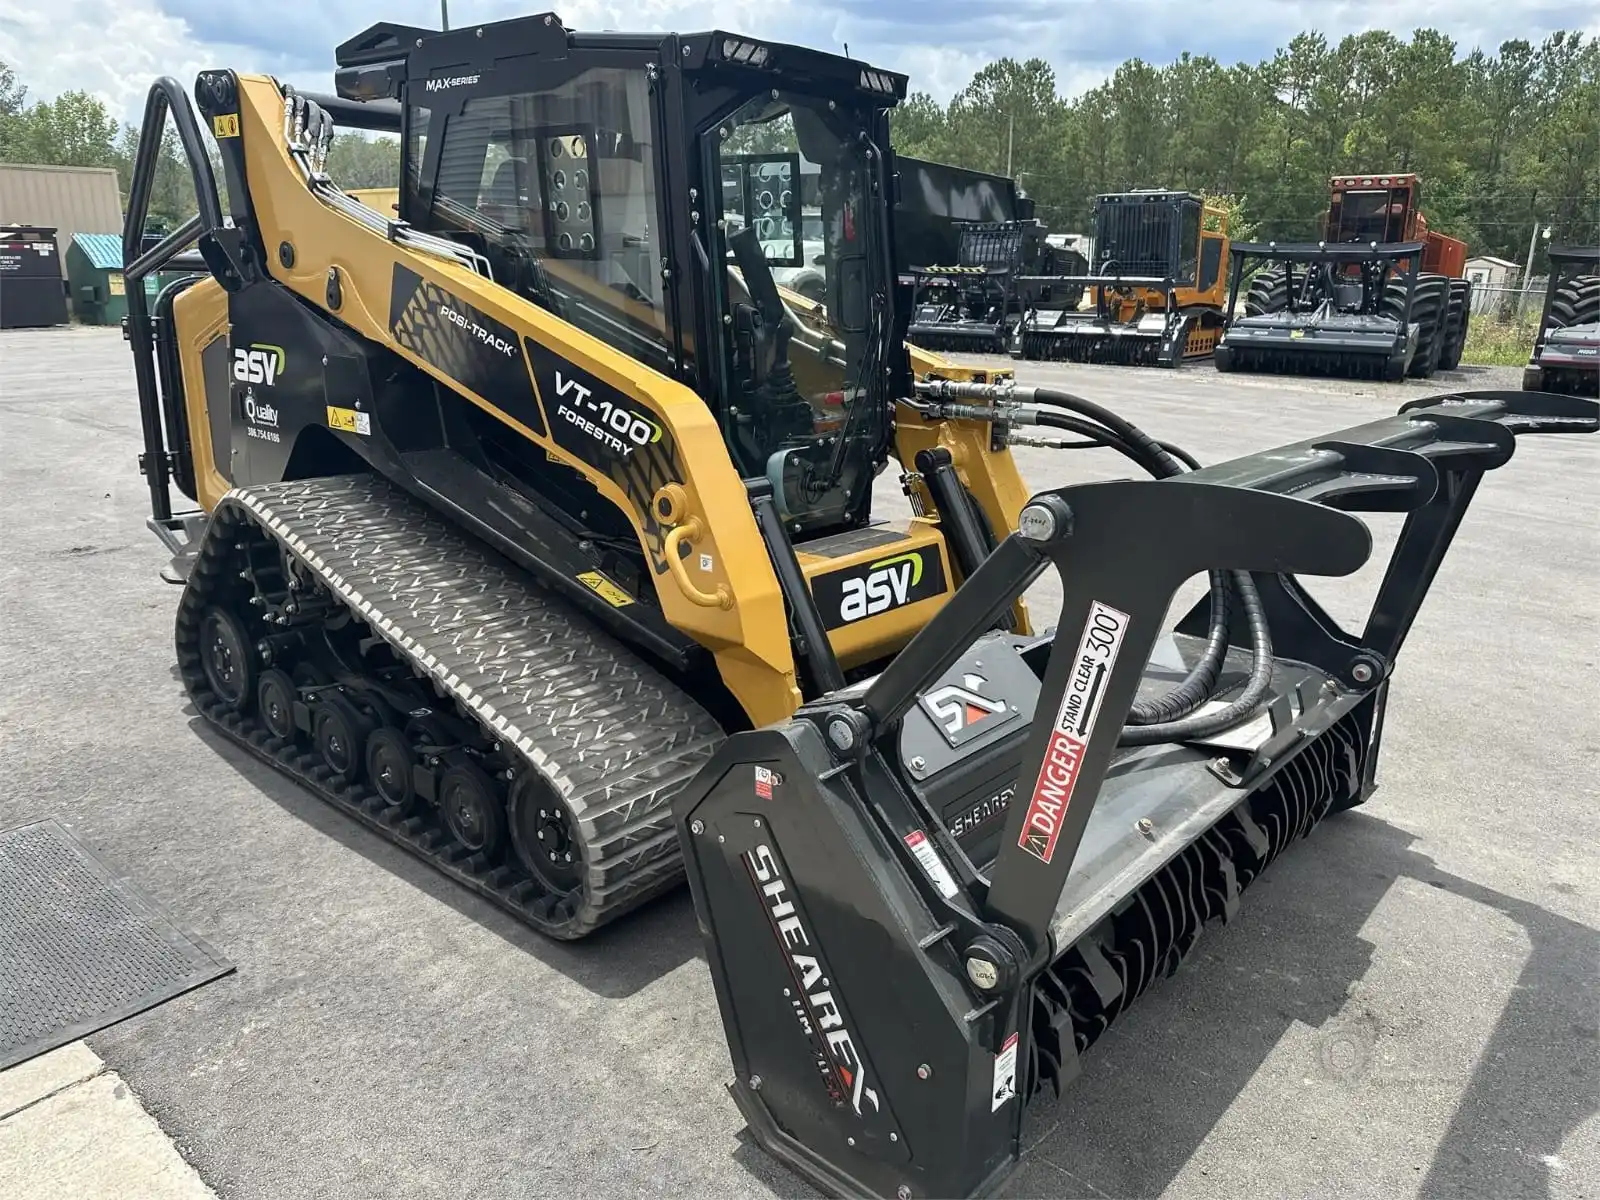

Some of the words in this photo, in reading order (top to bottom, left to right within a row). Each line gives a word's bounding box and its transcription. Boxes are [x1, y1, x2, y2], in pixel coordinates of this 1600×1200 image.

[440, 305, 514, 357] POSI-TRACK
[245, 396, 278, 426] Quality
[553, 371, 651, 445] VT-100
[557, 404, 633, 456] FORESTRY
[1060, 692, 1080, 734] STAND
[1074, 654, 1096, 692] CLEAR
[1029, 736, 1082, 836] DANGER
